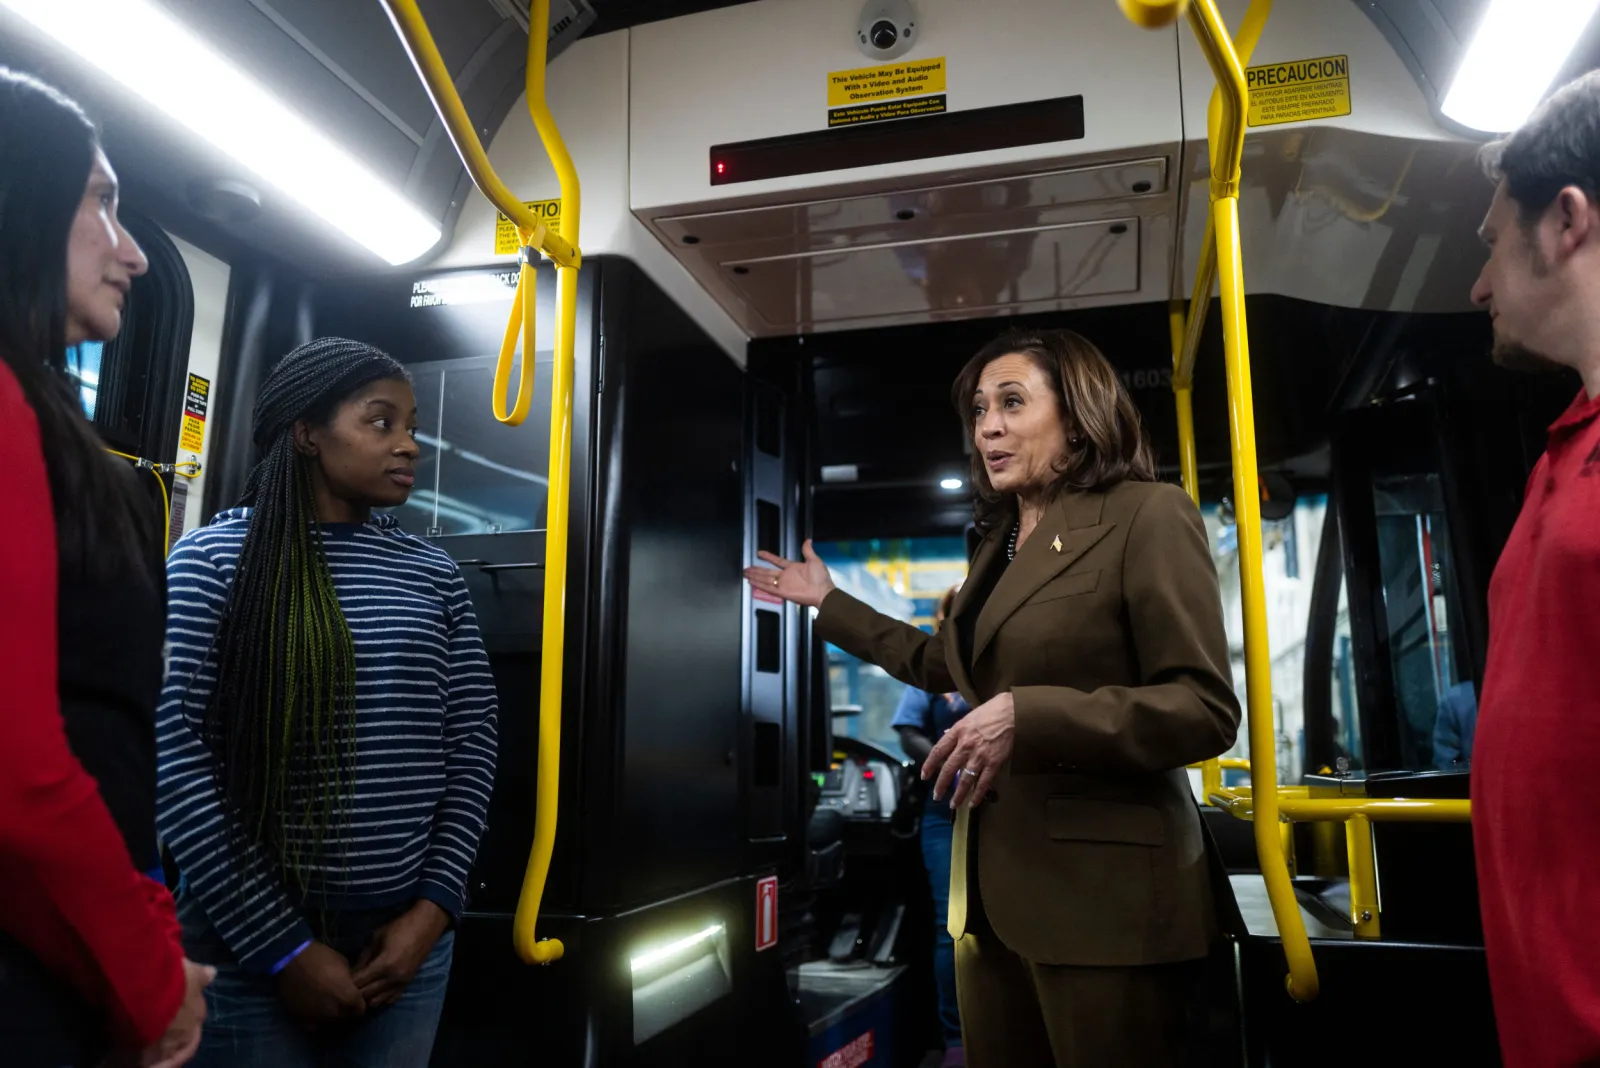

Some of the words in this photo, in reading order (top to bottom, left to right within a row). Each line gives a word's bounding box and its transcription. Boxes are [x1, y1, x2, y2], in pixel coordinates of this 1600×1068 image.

[849, 73, 876, 82] Vehicle
[878, 70, 893, 78] May
[906, 63, 941, 73] Equipped
[1247, 58, 1346, 87] PRECAUCION
[869, 79, 890, 88] Video
[907, 75, 929, 83] Audio
[849, 89, 894, 100] Observation
[895, 84, 923, 95] System
[1264, 89, 1283, 97] FAVOR
[1314, 82, 1343, 91] MIENTRAS
[1258, 97, 1285, 106] AUTOBUS
[1285, 95, 1299, 103] ESTE
[1308, 89, 1344, 99] MOVIMIENTO
[1276, 102, 1300, 111] SIEMPRE
[1301, 98, 1335, 108] PREPARADO
[1275, 109, 1301, 119] PARADAS
